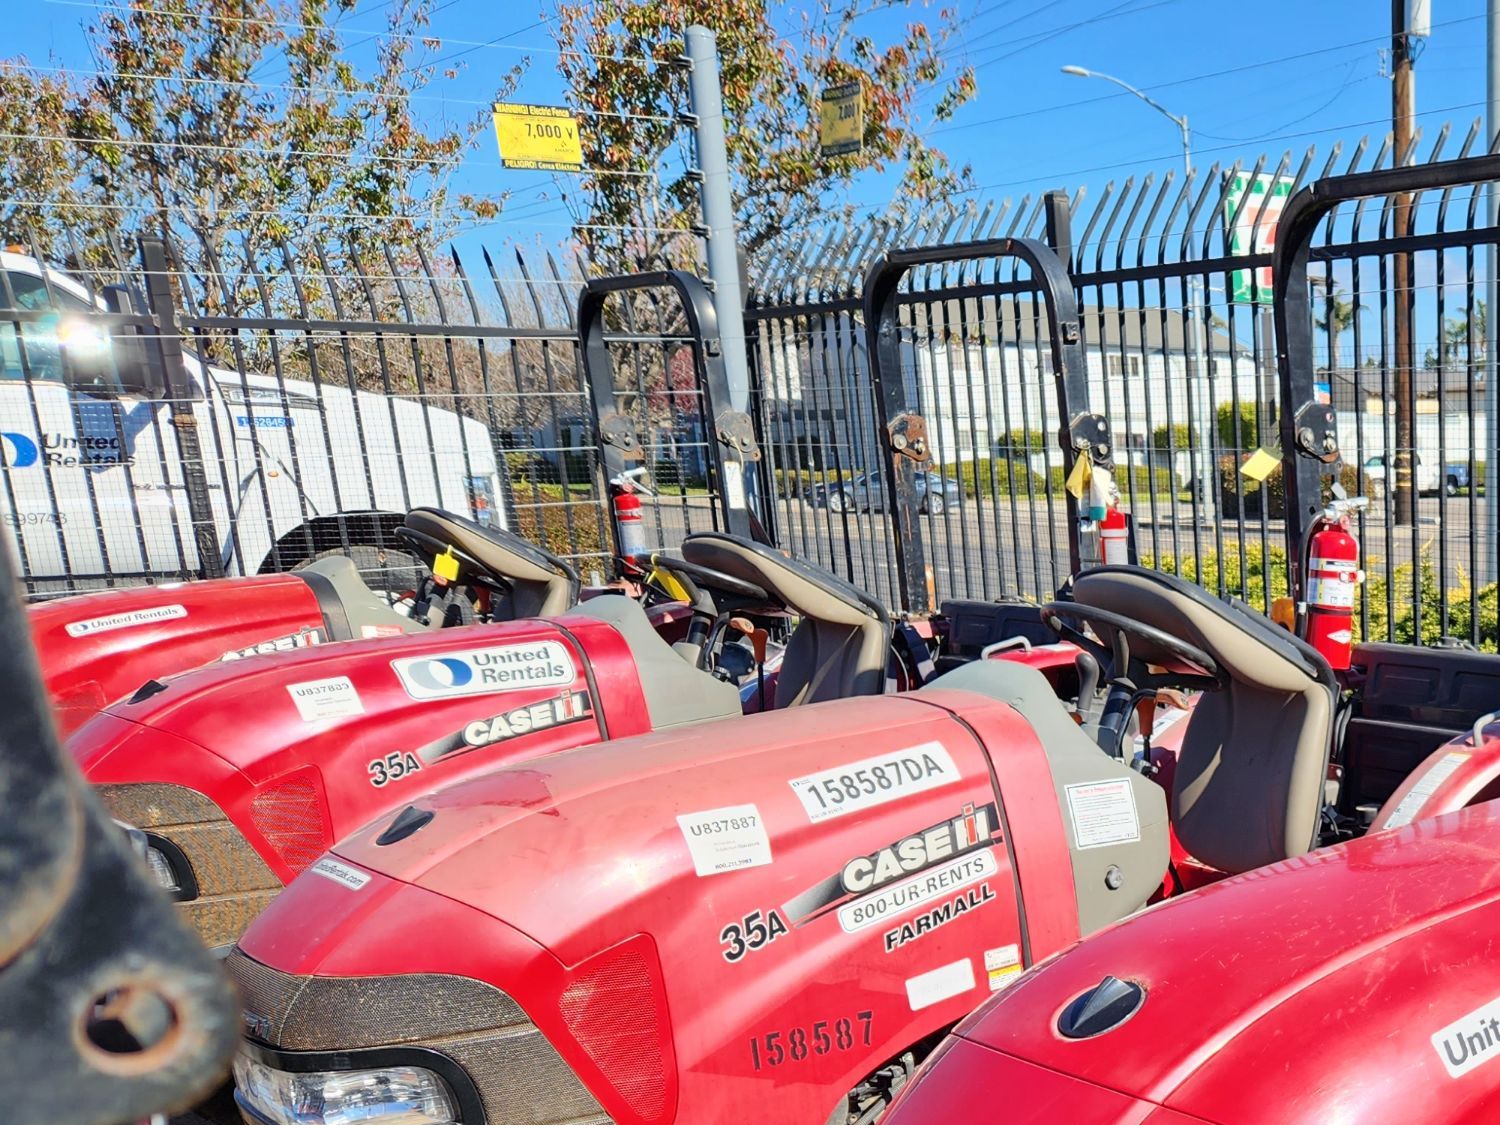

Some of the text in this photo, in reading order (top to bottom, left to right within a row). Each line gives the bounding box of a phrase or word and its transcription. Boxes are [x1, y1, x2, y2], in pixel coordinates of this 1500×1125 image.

[525, 123, 574, 139] 7,000 V
[91, 607, 178, 628] United Rentals
[473, 647, 551, 666] United
[482, 661, 565, 684] Rentals
[464, 706, 552, 746] CASE
[369, 754, 419, 786] 35A
[808, 753, 944, 808] 158587DA
[690, 815, 756, 836] U837887
[842, 824, 952, 892] CASE
[853, 857, 985, 924] 800-UR-RENTS
[721, 911, 788, 960] 35A
[885, 884, 996, 951] FARMALL
[751, 1010, 873, 1071] 158587
